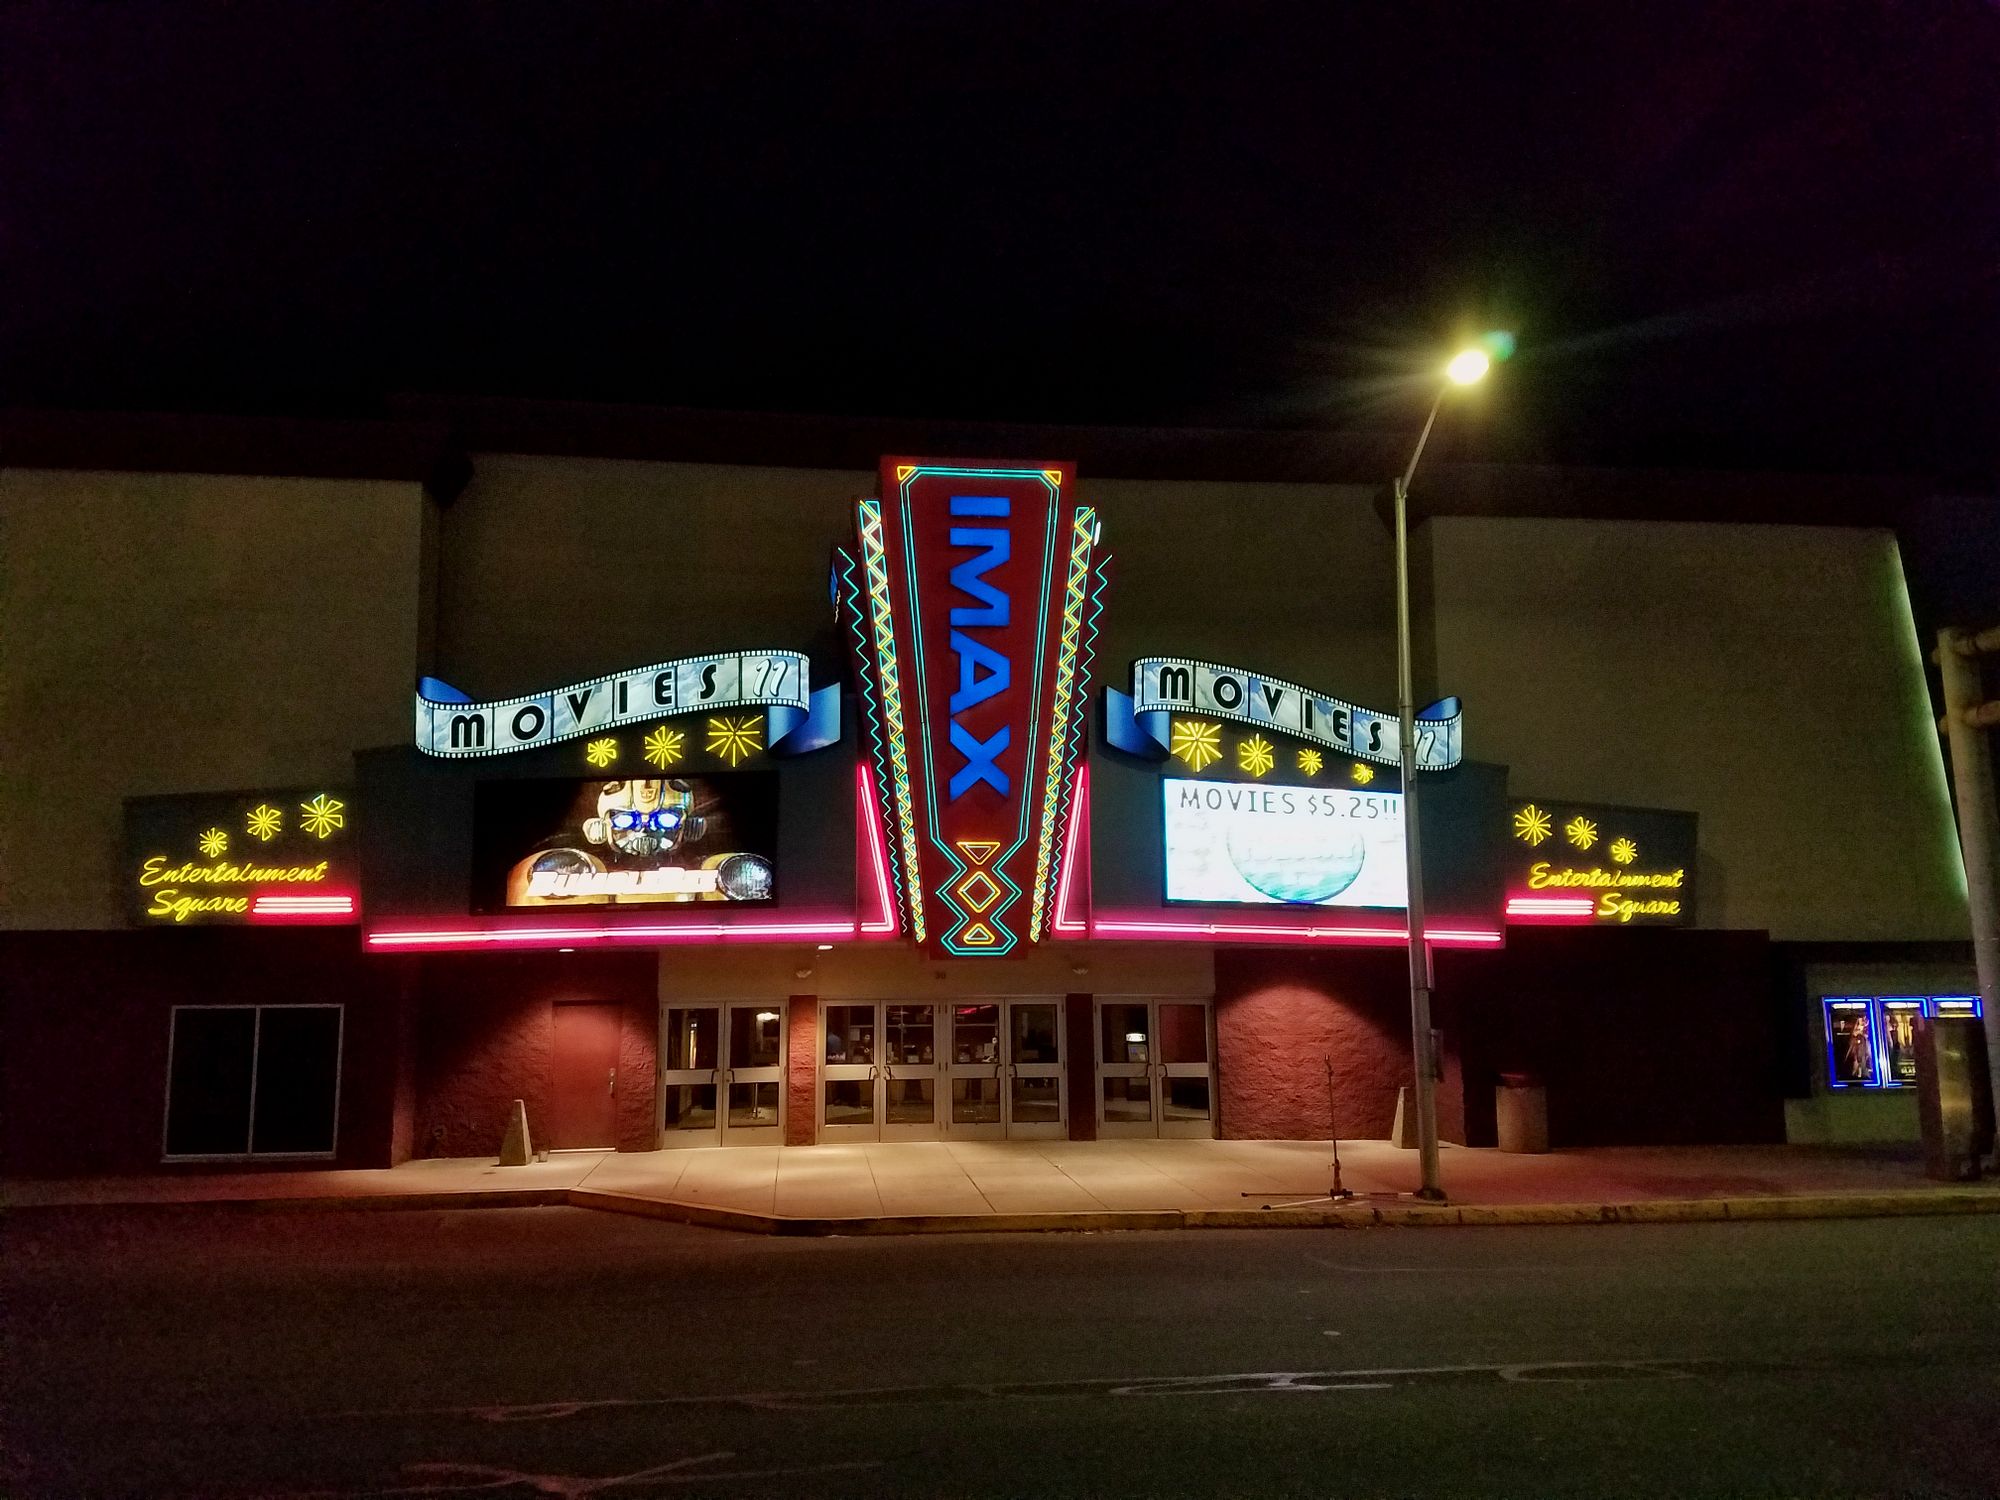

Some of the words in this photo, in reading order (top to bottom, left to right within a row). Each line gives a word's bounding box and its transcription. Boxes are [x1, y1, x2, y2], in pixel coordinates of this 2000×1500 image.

[949, 495, 1011, 801] IMAX
[449, 662, 719, 751] MOVIES
[752, 657, 790, 699] 11
[1158, 664, 1384, 754] MOVIES
[1179, 786, 1296, 815] MOVIES
[1307, 794, 1398, 821] $5.25!!
[139, 855, 329, 887] Entertainment
[1528, 861, 1685, 890] Entertainment
[147, 889, 250, 923] Square
[1597, 892, 1682, 923] Square
